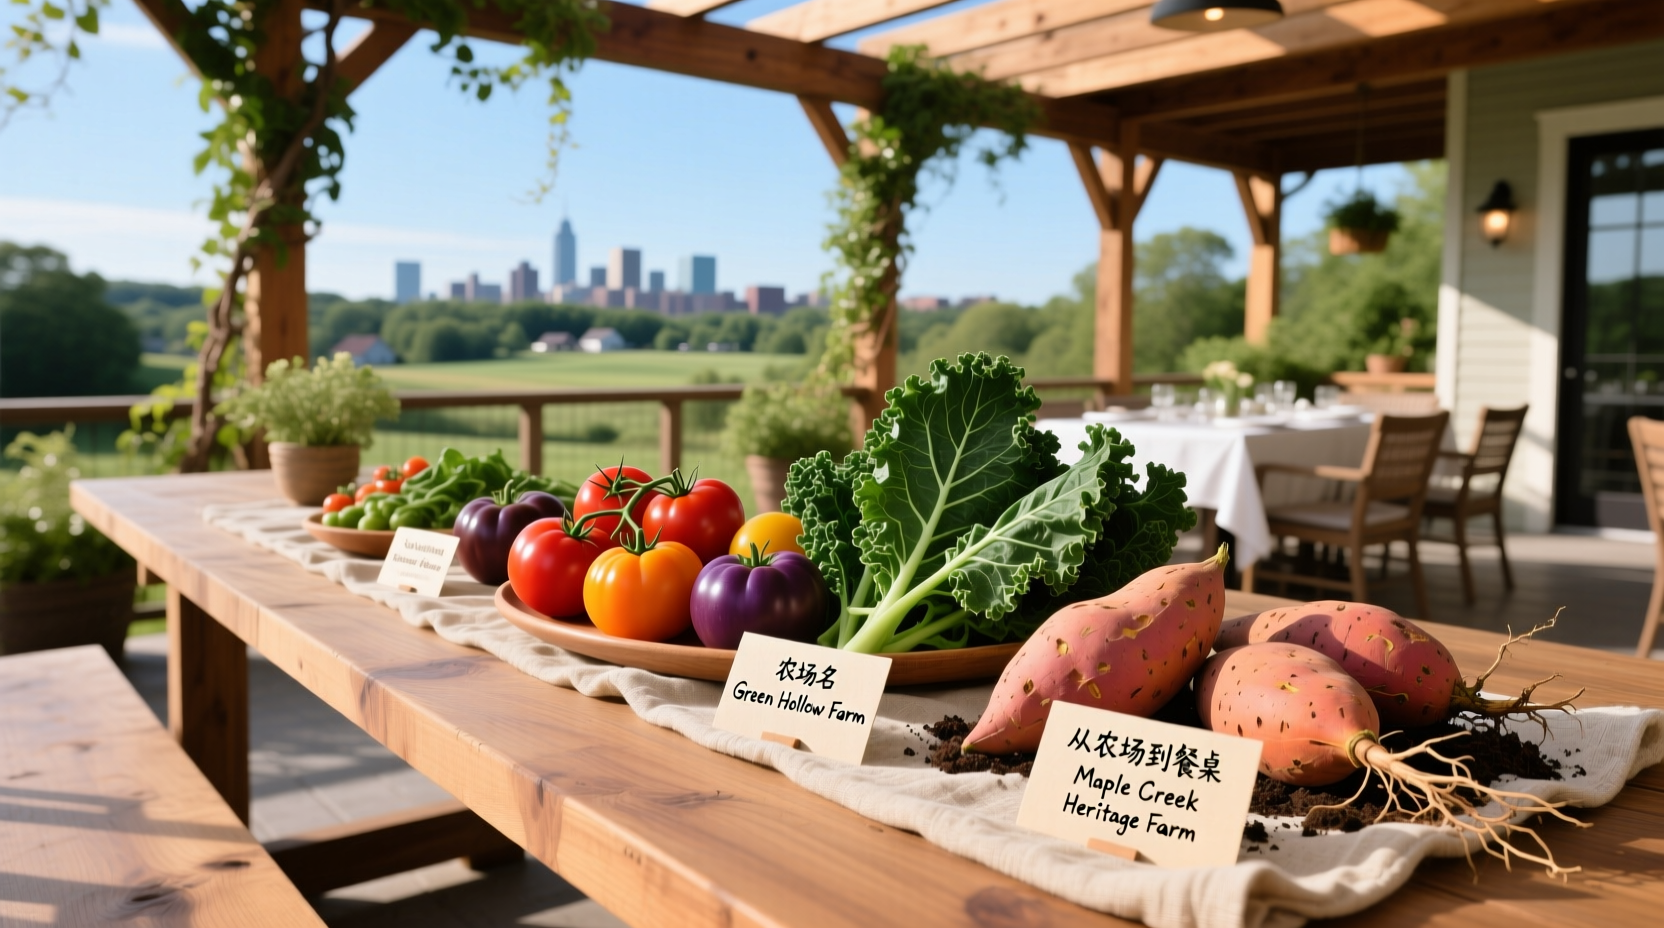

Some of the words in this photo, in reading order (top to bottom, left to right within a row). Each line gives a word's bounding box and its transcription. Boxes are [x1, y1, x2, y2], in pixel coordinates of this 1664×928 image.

[775, 657, 837, 690] 农场名
[733, 681, 774, 706] Green
[777, 691, 825, 716] Hollow
[828, 701, 865, 725] Farm
[1067, 727, 1222, 783] 从农场到餐桌
[1073, 765, 1131, 799] Maple
[1138, 781, 1199, 812] Creek
[1063, 792, 1139, 836] Heritage
[1146, 812, 1196, 842] Farm
